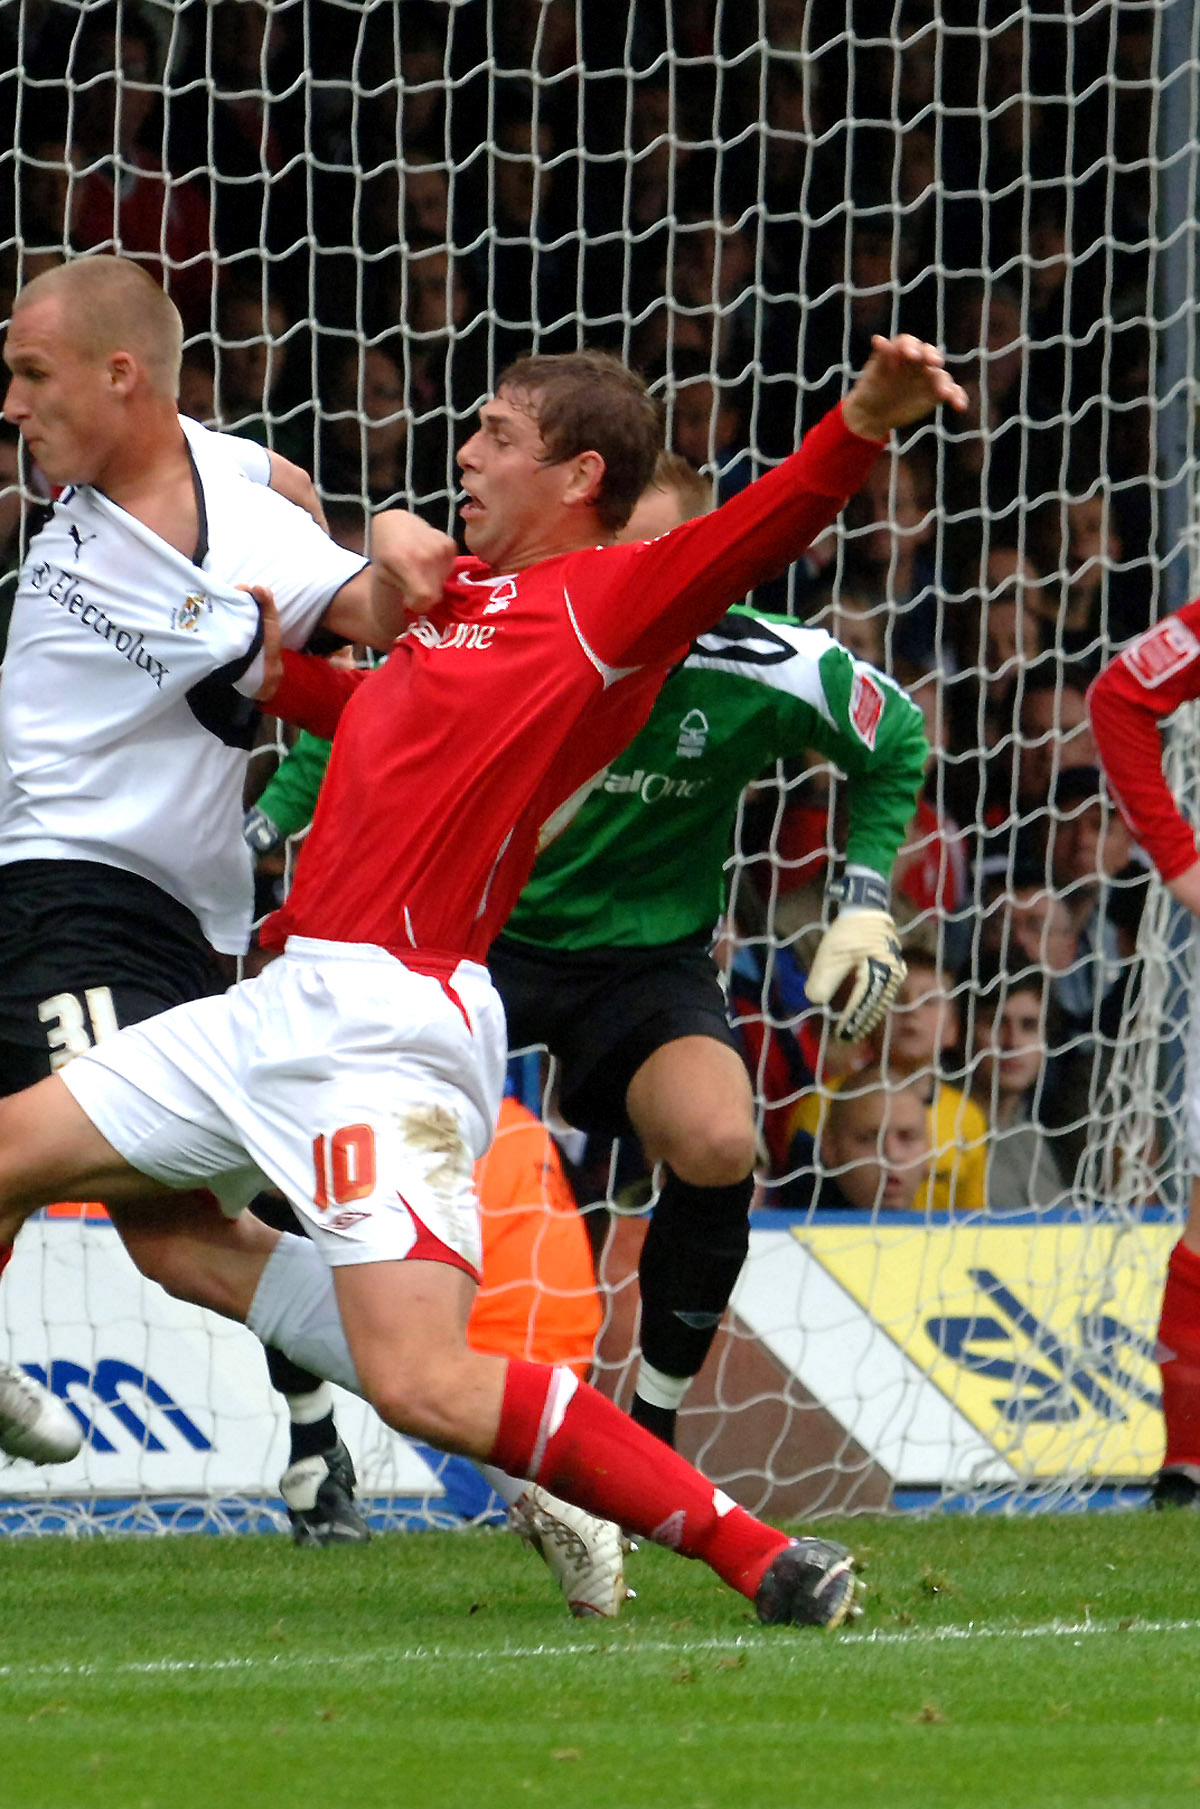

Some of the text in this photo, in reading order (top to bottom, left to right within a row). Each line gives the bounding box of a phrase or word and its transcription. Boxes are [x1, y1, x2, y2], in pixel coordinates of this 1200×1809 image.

[48, 569, 169, 689] Electrolux
[37, 986, 119, 1075] 31
[312, 1123, 376, 1212] 10
